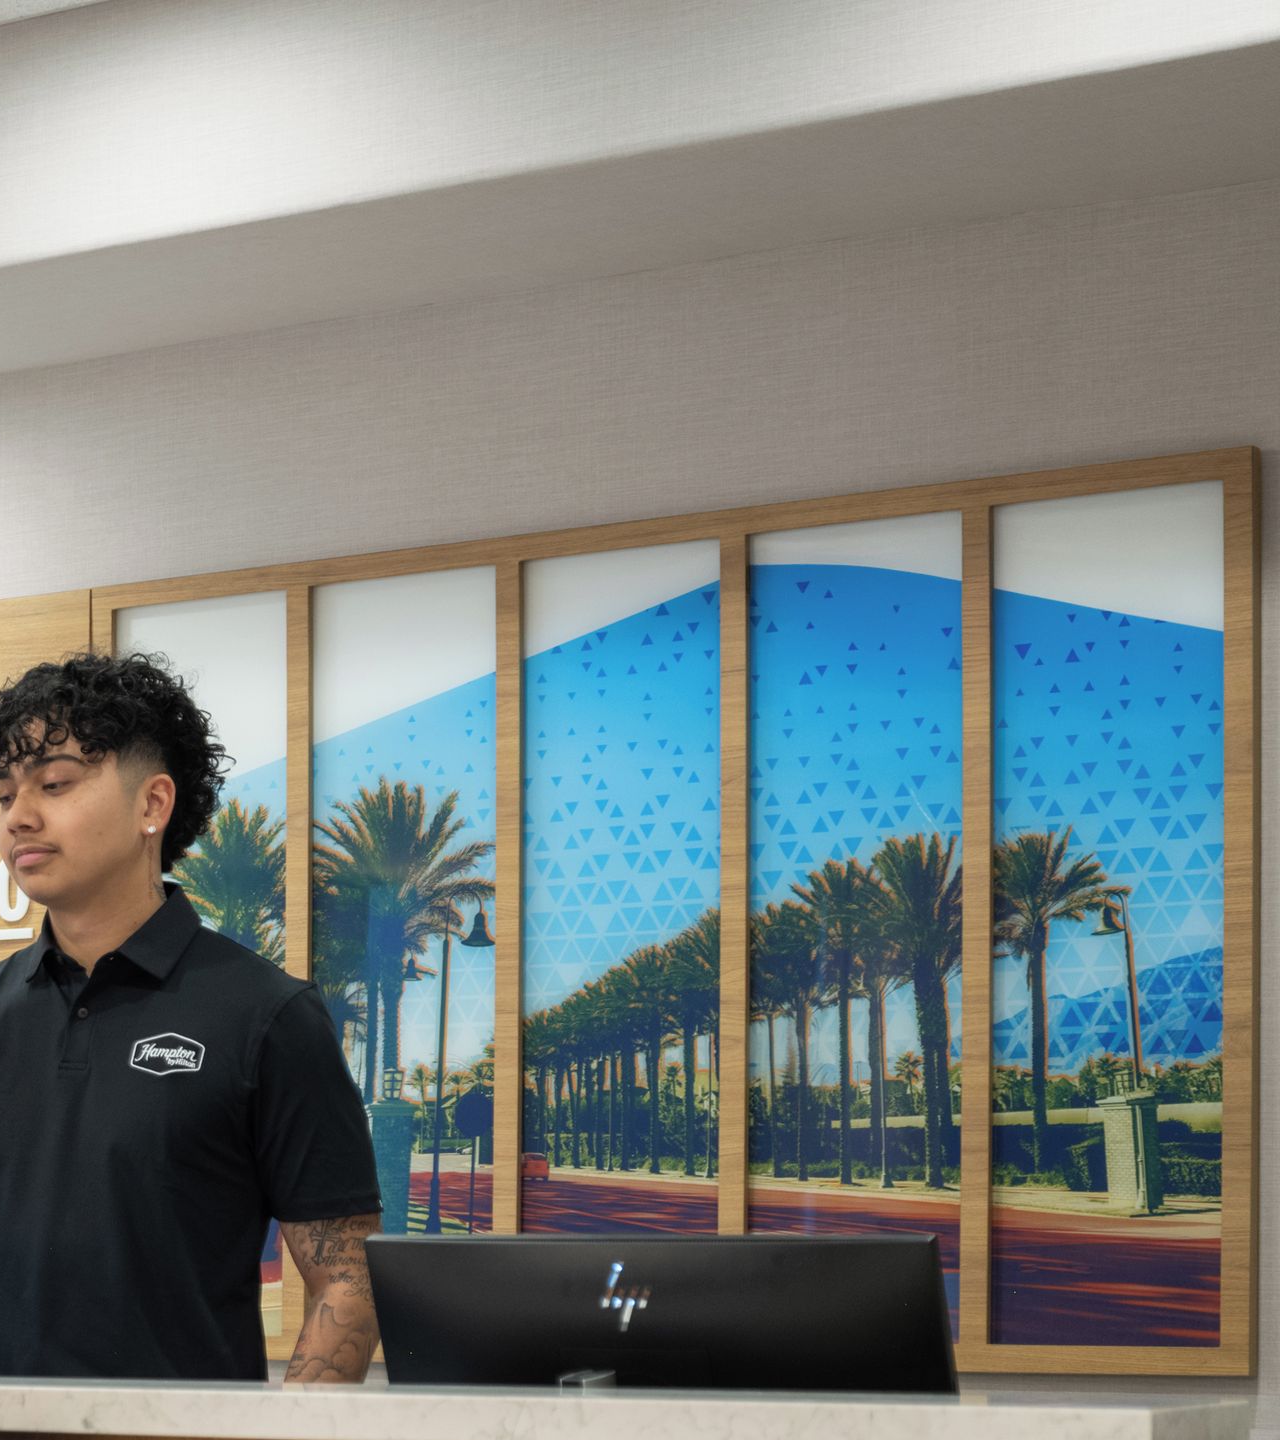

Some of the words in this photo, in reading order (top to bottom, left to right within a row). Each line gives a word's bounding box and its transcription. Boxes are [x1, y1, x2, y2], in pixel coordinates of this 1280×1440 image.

[135, 1043, 197, 1062] Hampton
[167, 1058, 176, 1066] by
[176, 1059, 196, 1068] Hilton
